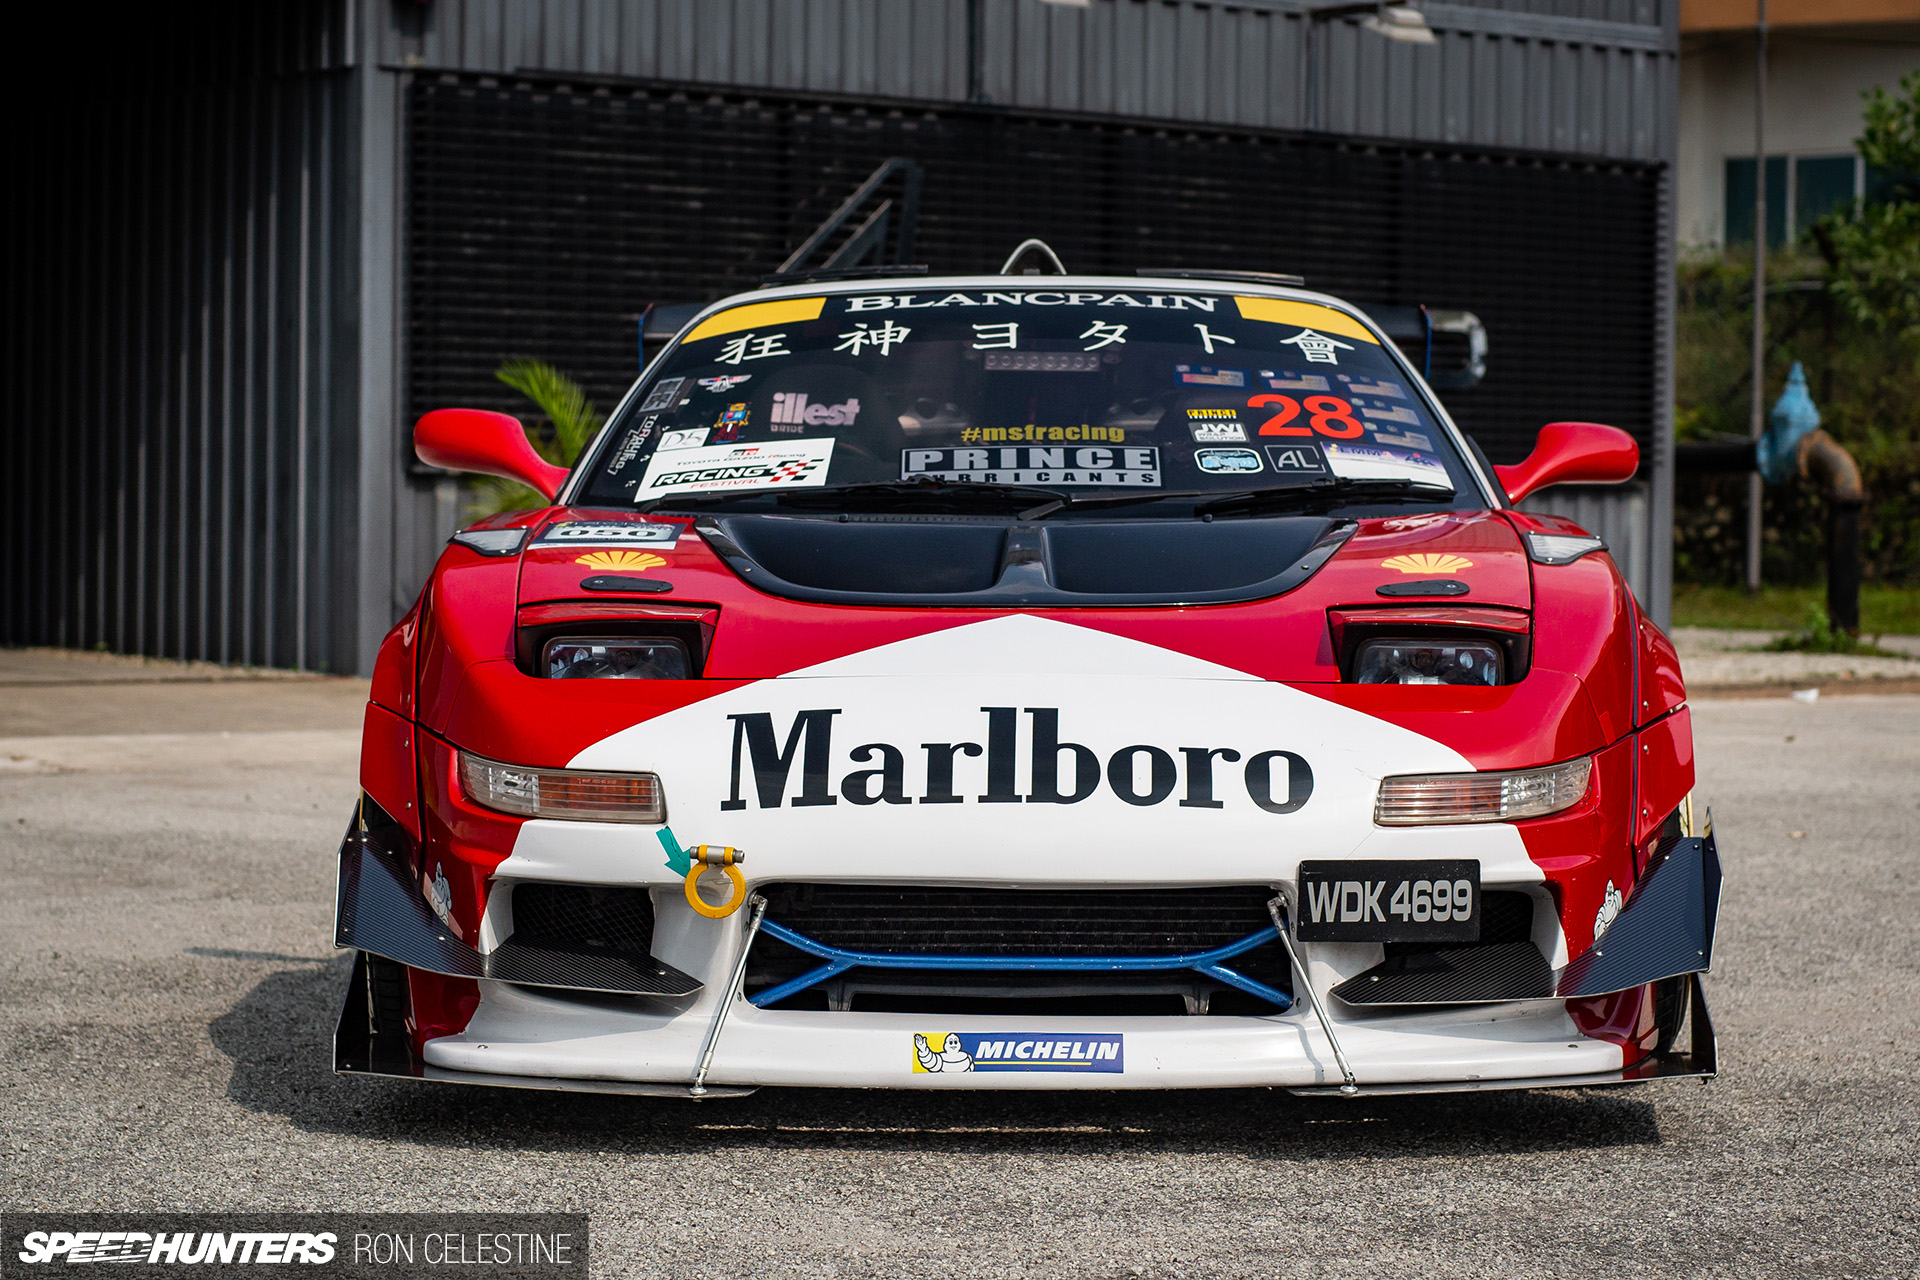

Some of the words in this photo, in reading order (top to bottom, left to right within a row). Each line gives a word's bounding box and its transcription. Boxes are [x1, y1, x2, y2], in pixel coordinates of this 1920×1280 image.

[845, 292, 1219, 313] BLANCPAIN
[770, 392, 860, 426] illest
[1247, 393, 1364, 439] 28
[961, 424, 1125, 443] #msfracing
[909, 448, 1153, 472] PRINCE
[1278, 450, 1318, 468] AL
[655, 467, 766, 486] RACING
[690, 479, 760, 489] FESTIVAL
[908, 473, 1155, 483] UBRICANTS
[560, 529, 657, 537] 050
[721, 706, 1315, 814] Marlboro
[1307, 880, 1387, 923] WDK
[1390, 879, 1472, 923] 4699
[975, 1041, 1120, 1060] MICHELIN
